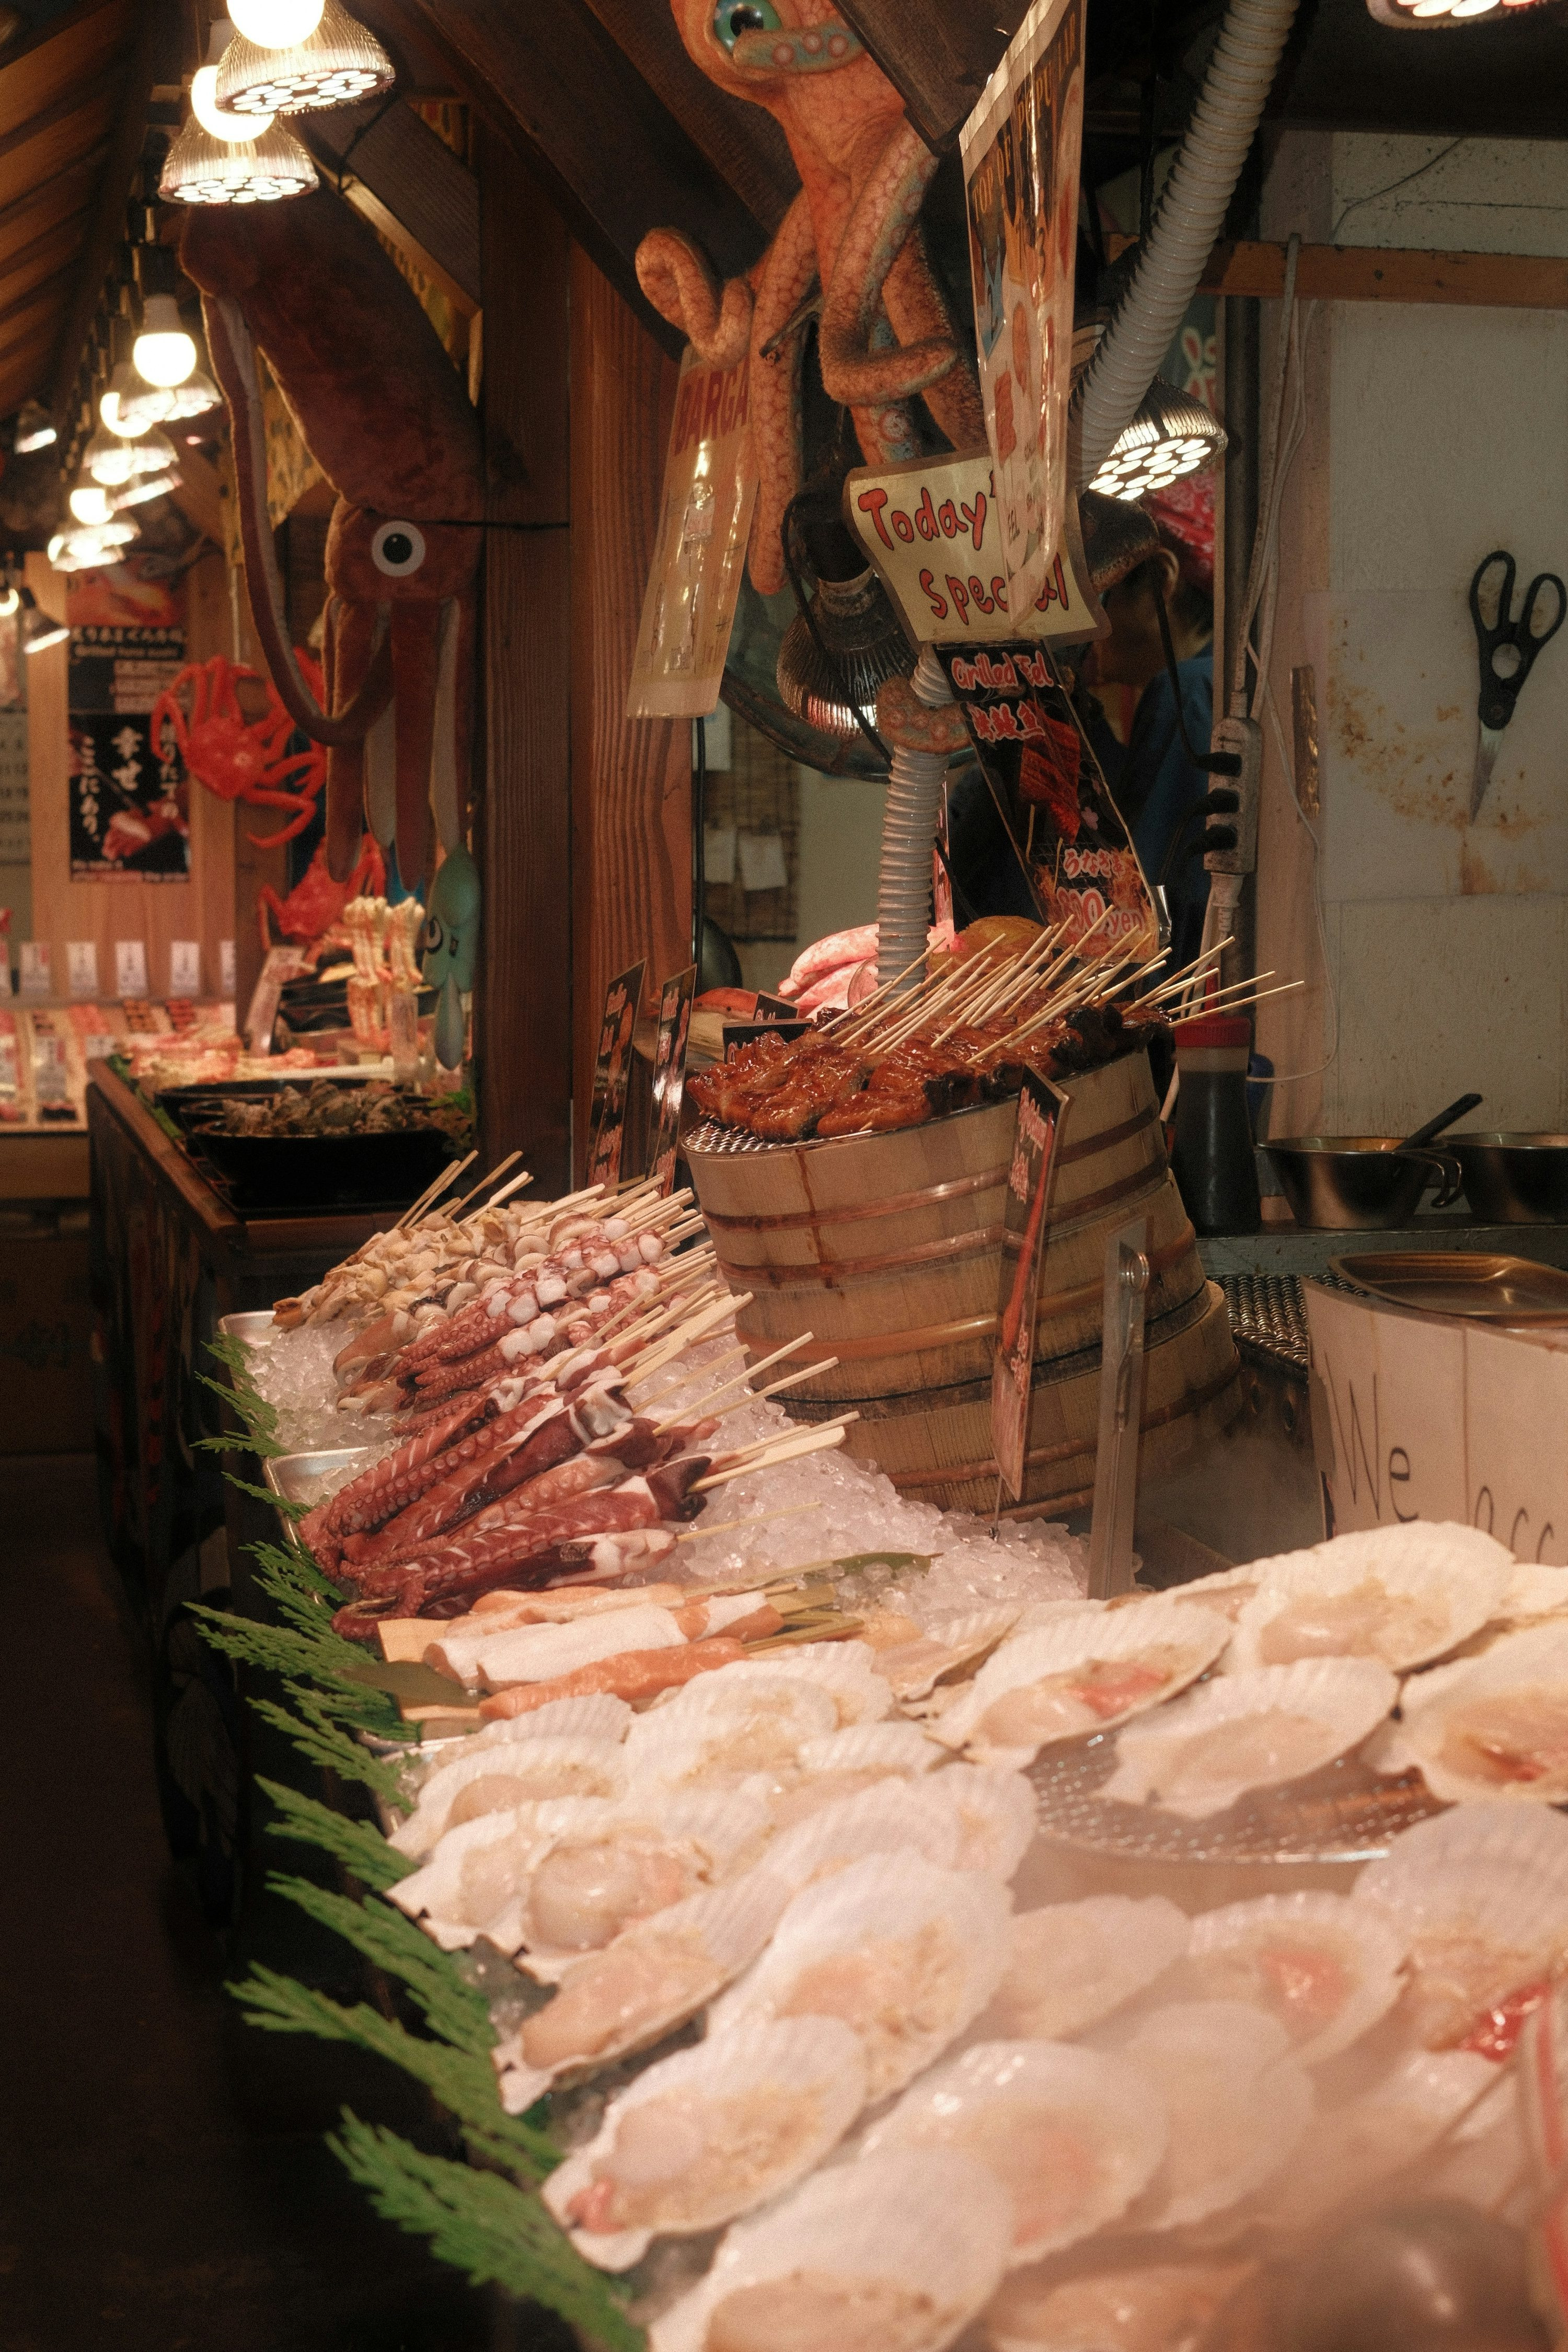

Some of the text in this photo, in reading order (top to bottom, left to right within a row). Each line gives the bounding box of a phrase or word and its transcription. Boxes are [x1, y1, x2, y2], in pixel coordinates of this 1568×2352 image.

[972, 165, 994, 223] TOP
[996, 134, 1011, 188] OF
[918, 551, 1070, 626] Specal
[951, 649, 1055, 690] Grilled Eel
[111, 725, 144, 792] 幸せ
[1106, 908, 1146, 939] yen
[1324, 1350, 1419, 1523] We
